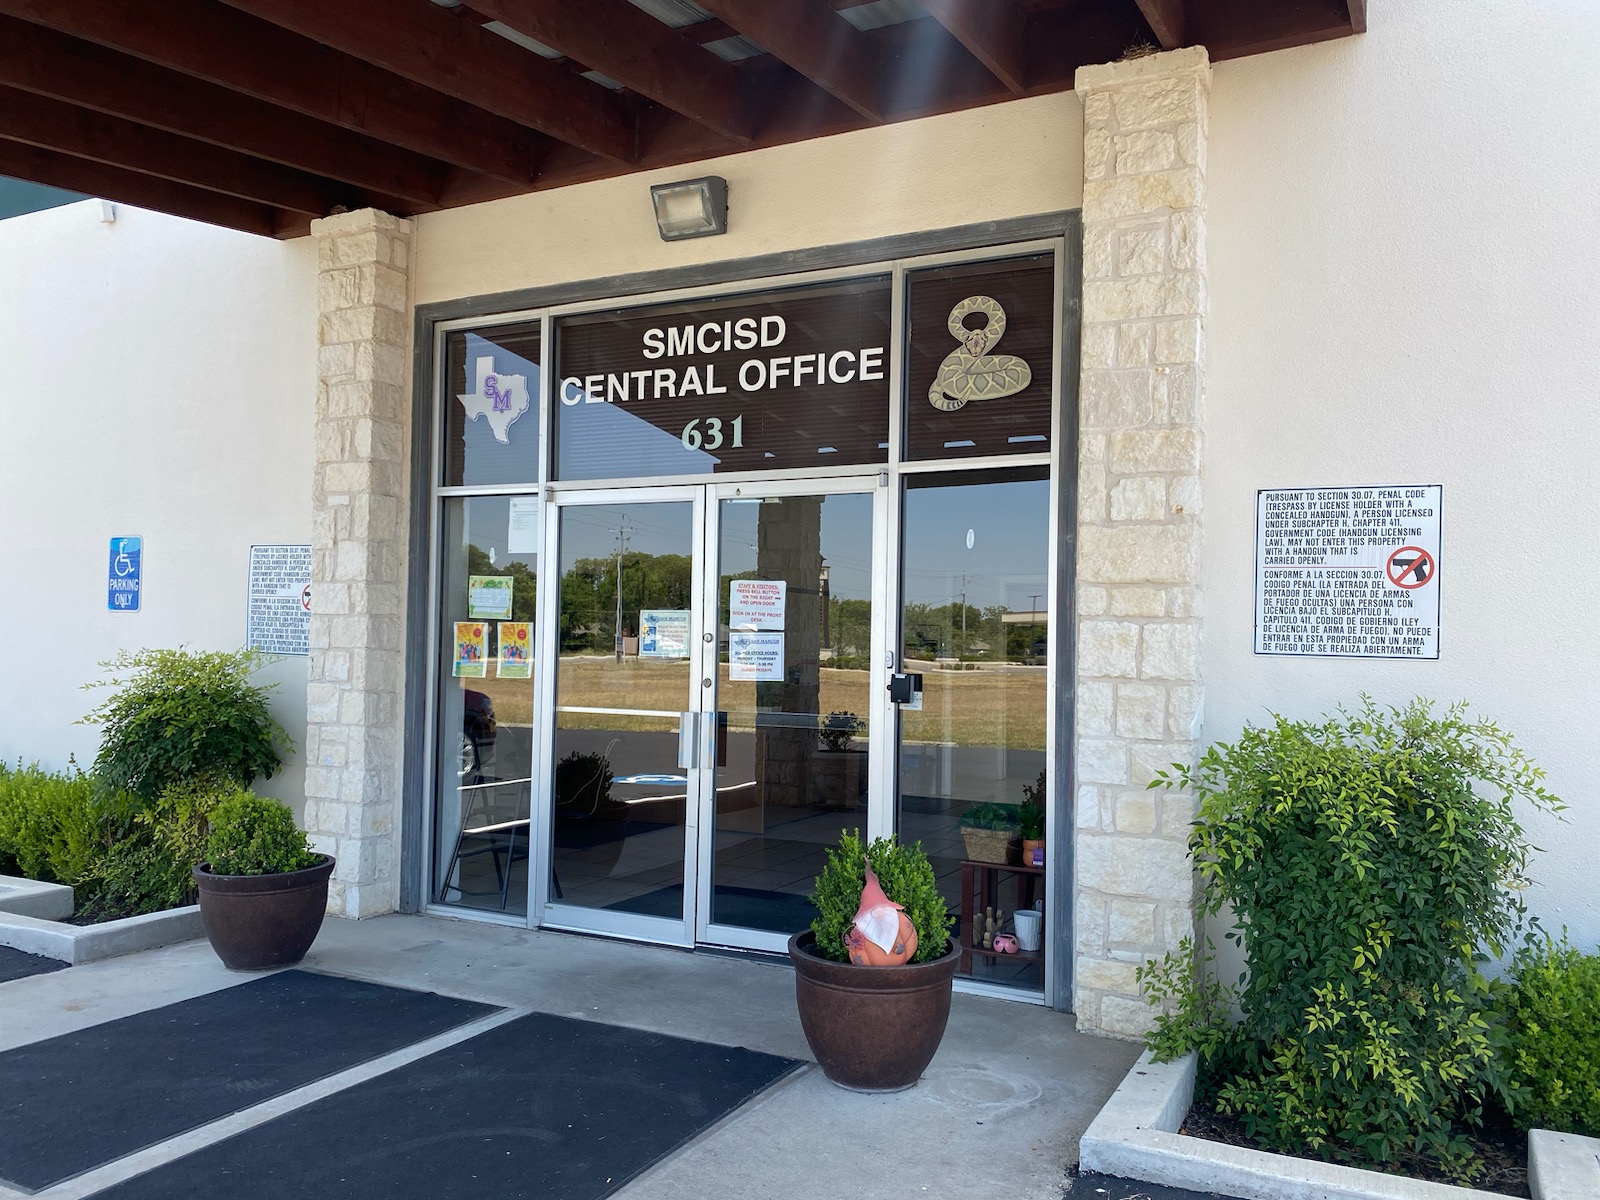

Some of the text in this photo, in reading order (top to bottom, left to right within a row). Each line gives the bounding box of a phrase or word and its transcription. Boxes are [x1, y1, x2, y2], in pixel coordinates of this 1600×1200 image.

[642, 315, 786, 359] SMCISD
[560, 347, 884, 406] CENTRAL OFFICE
[681, 414, 744, 451] 631
[1266, 493, 1303, 502] PURSUANT
[1306, 493, 1315, 501] TO
[1317, 492, 1349, 501] SECTION
[1378, 490, 1402, 499] PENAL
[1405, 489, 1425, 498] CODE
[1266, 499, 1413, 511] (TRESPASS BY LICENSE HOLDER WITH A
[1265, 511, 1308, 520] CONCEALED
[1354, 510, 1359, 518] A
[1362, 509, 1392, 518] PERSON
[1395, 508, 1433, 518] LICENSED
[1265, 520, 1289, 529] UNDER
[1292, 519, 1340, 528] SUBCHAPTER
[1352, 518, 1387, 527] CHAPTER
[1265, 527, 1422, 538] GOVERNMENT CODE (HANDGUN LICENSING
[1287, 538, 1303, 547] MAY
[1305, 538, 1320, 546] NOT
[1322, 538, 1346, 546] ENTER
[1348, 537, 1365, 546] THIS
[1368, 537, 1406, 546] PROPERTY
[1264, 547, 1358, 556] WITH A HANDGUN THAT IS
[1264, 556, 1295, 565] CARRIED
[1264, 571, 1304, 579] CONFORME
[1306, 571, 1312, 579] A
[1314, 571, 1324, 579] LA
[1326, 571, 1358, 579] SECCION
[110, 579, 139, 591] PARKING
[1264, 580, 1386, 589] CODIGO PENAL (LA ENTRADA DEL
[115, 593, 133, 605] ONLY
[1264, 590, 1410, 599] PORTADOR DE UNA LICENCIA DE ARMAS
[1263, 598, 1413, 608] DE FUEGO OCULTAS) UNA PERSONA CON
[1263, 607, 1296, 615] LICENCIA
[1298, 607, 1318, 615] BAJO
[1320, 607, 1329, 615] EL
[1331, 608, 1382, 616] SUBCAPITULO
[1263, 616, 1298, 624] CAPITULO
[1316, 616, 1344, 625] CODIGO
[1346, 617, 1356, 625] DE
[1359, 617, 1398, 626] GOBIERNO
[1401, 618, 1419, 626] (LEY
[1263, 624, 1272, 633] DE
[1275, 625, 1308, 634] LICENCIA
[1310, 625, 1320, 634] DE
[1323, 626, 1345, 634] ARMA
[1347, 626, 1357, 635] DE
[1393, 627, 1404, 636] NO
[1406, 627, 1432, 636] PUEDE
[1263, 634, 1425, 646] ENTRAR EN ESTA PROPIEDAD CON UN ARMA
[1262, 643, 1272, 651] DE
[1274, 643, 1298, 652] FUEGO
[1300, 644, 1315, 652] QUE
[1318, 644, 1327, 653] SE
[1330, 644, 1361, 654] REALIZA
